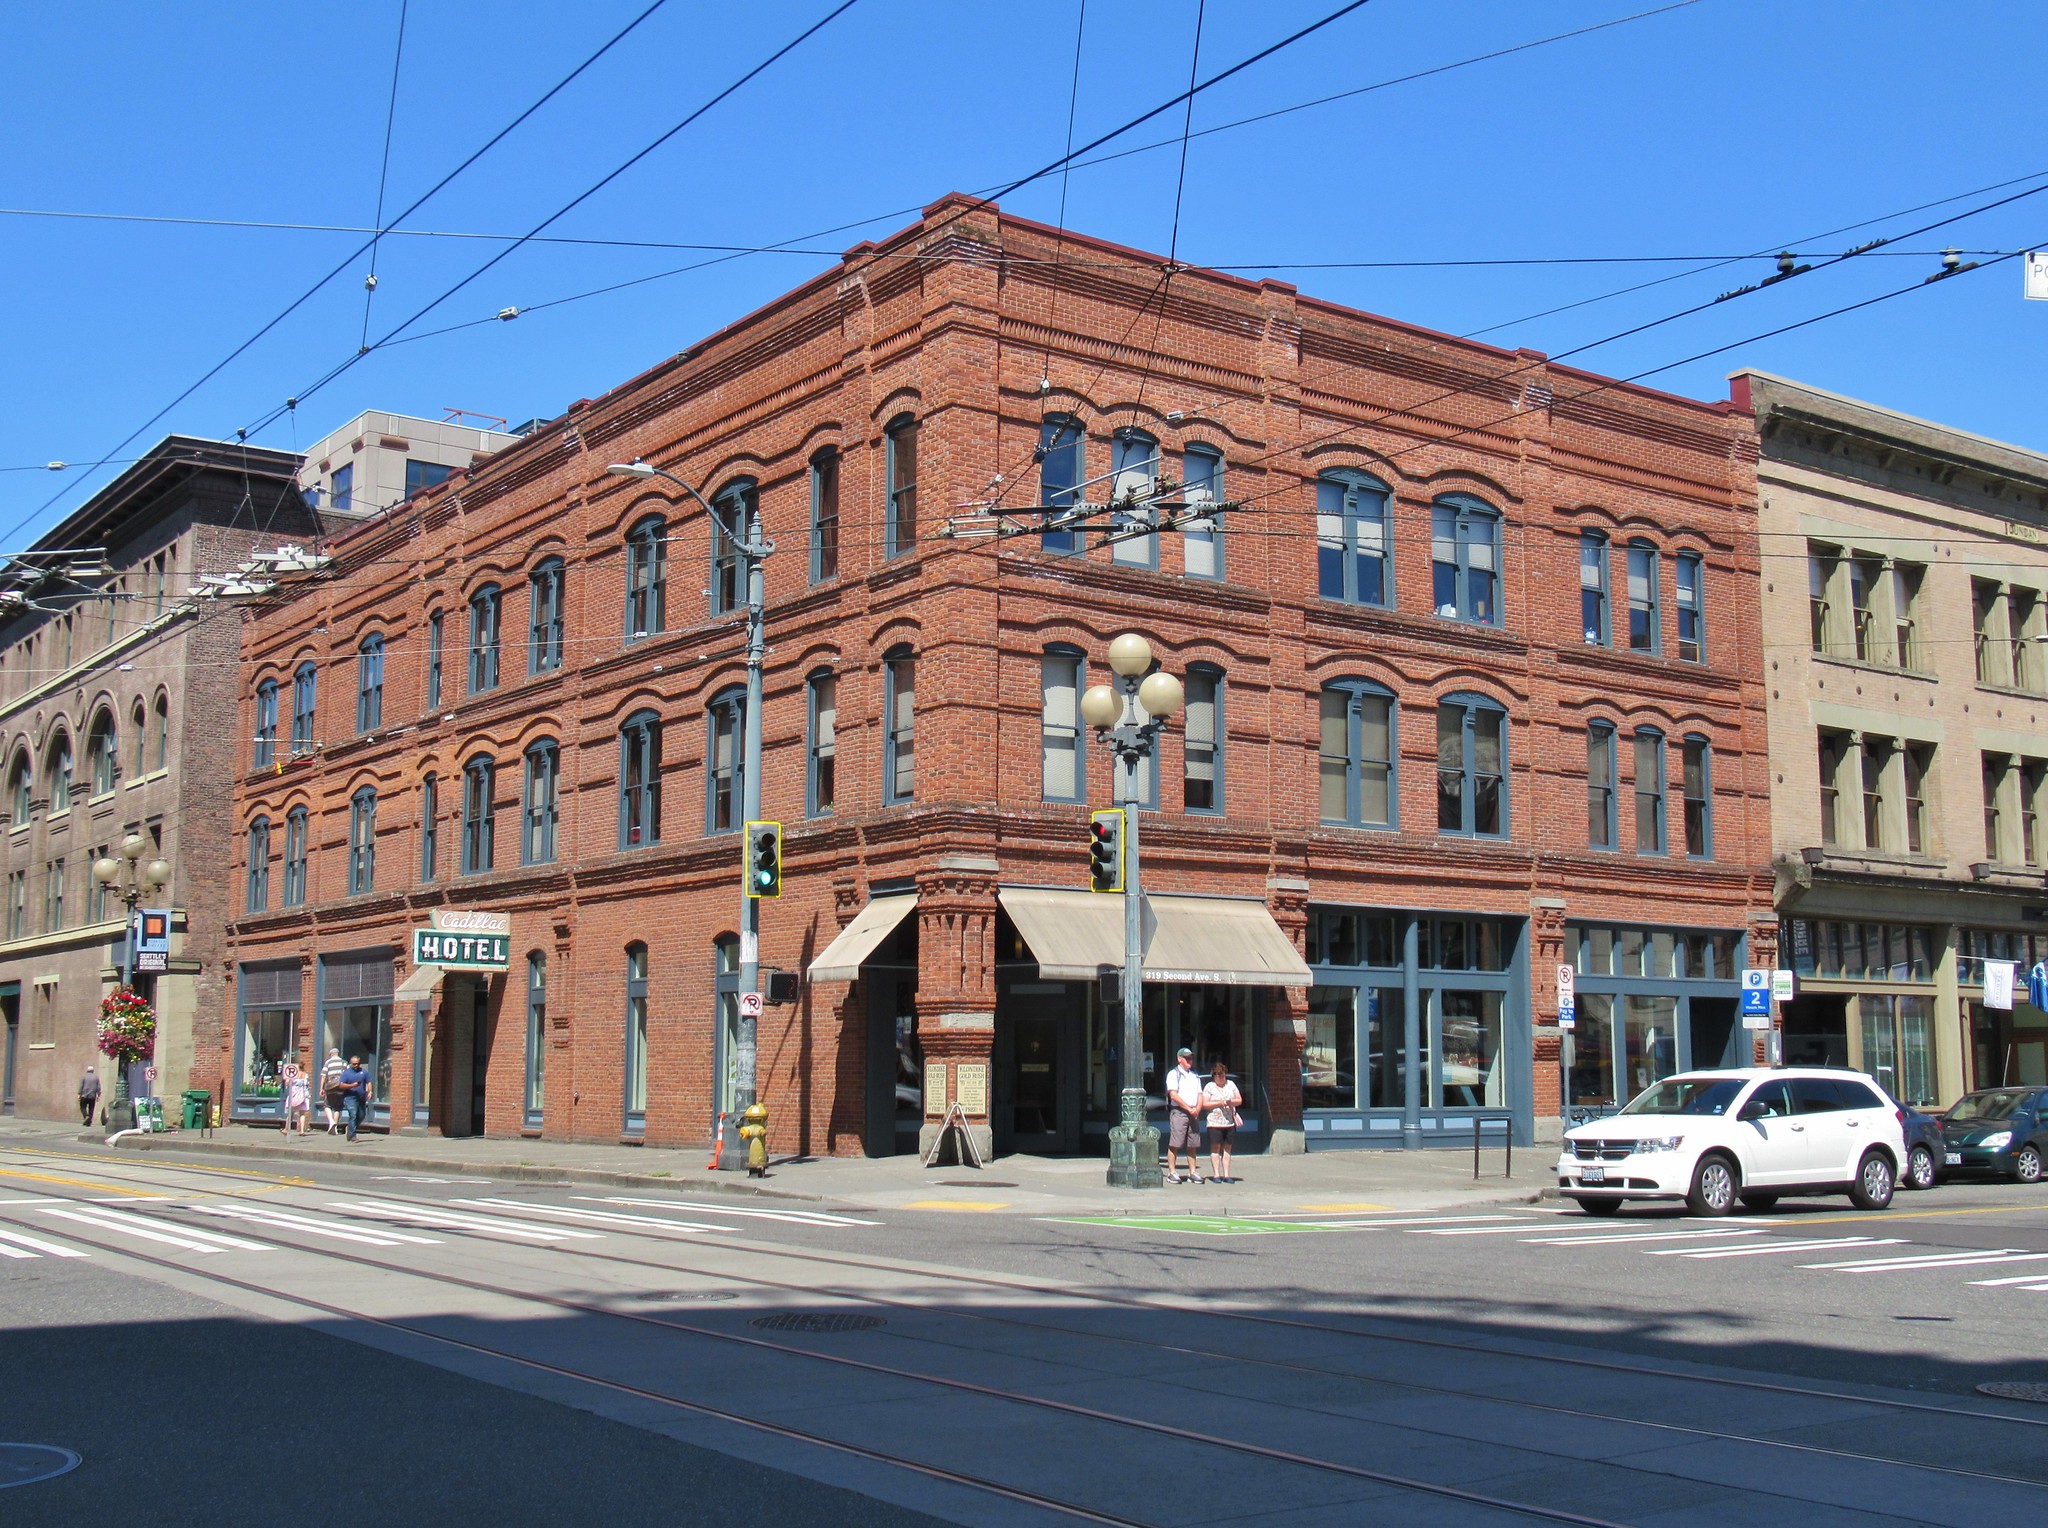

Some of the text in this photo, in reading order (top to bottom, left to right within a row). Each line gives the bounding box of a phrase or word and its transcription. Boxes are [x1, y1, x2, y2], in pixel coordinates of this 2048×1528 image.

[2034, 264, 2048, 278] P
[441, 912, 507, 930] Cadillac
[421, 936, 507, 961] HOTEL
[1145, 971, 1222, 981] 319 Second Ave. S.
[1751, 991, 1761, 1005] 2
